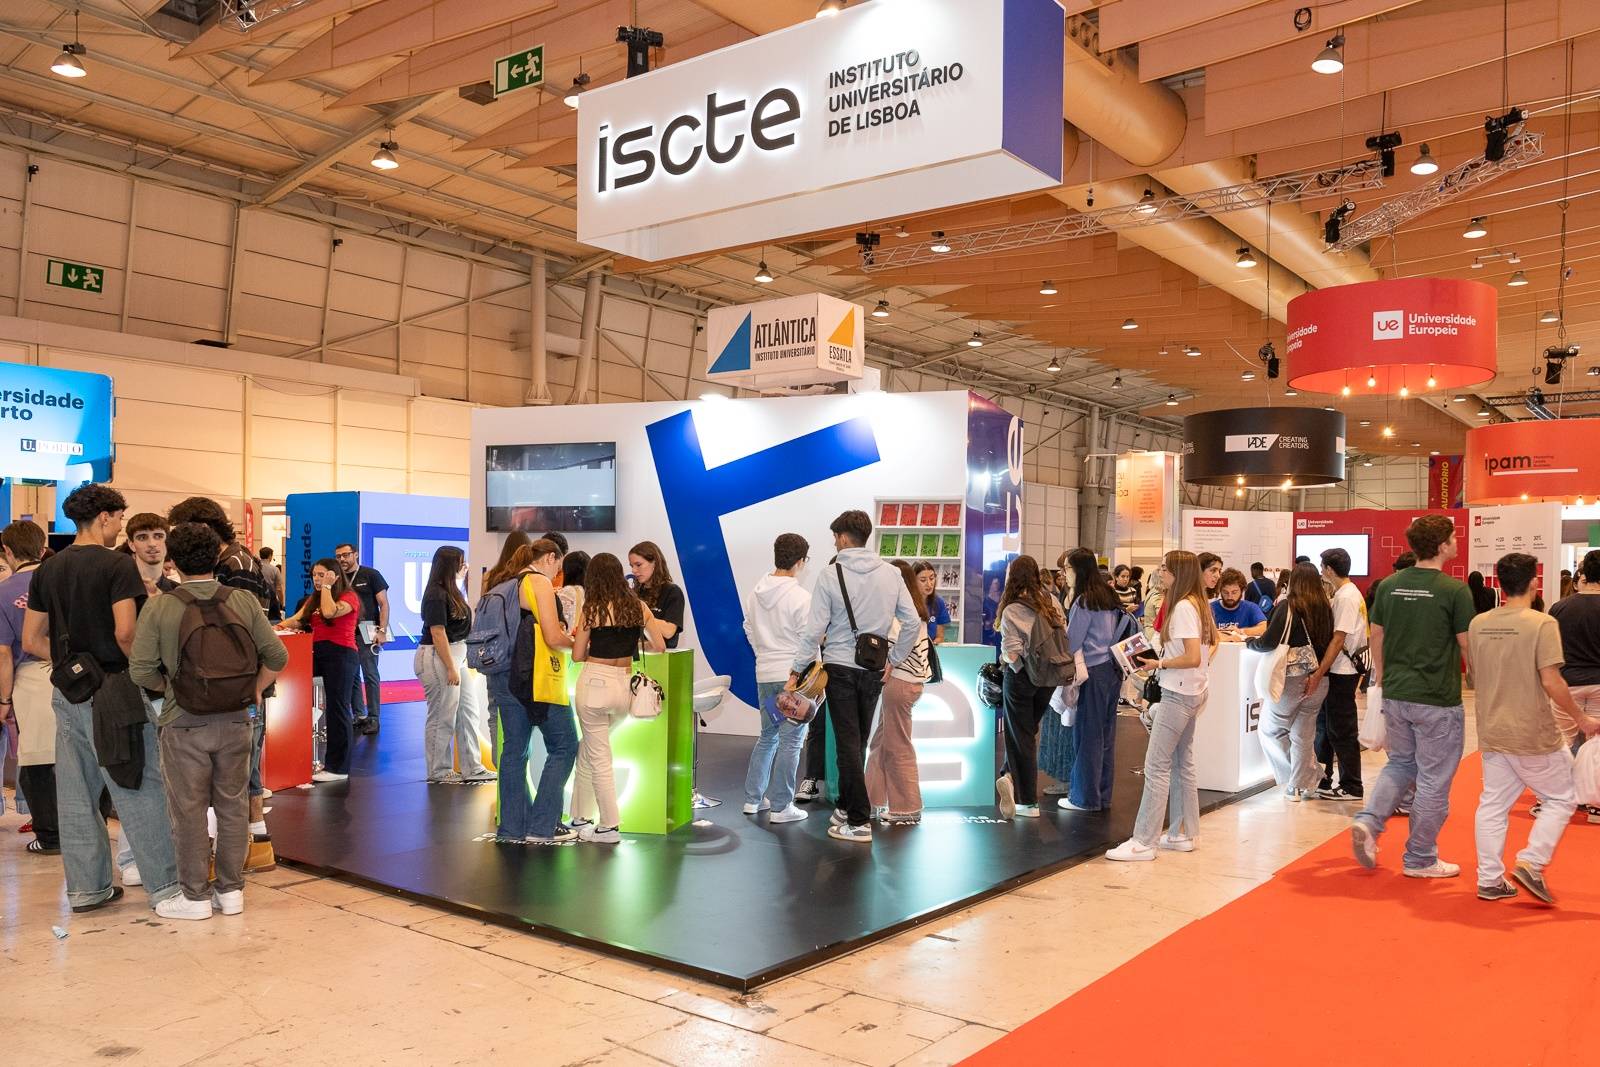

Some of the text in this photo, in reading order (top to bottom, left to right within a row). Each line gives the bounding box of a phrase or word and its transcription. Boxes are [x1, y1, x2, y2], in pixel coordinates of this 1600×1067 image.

[829, 49, 920, 89] INSTITUTO
[829, 62, 964, 112] UNIVERSITÁRIO
[828, 99, 921, 137] DE LISBOA
[598, 87, 801, 193] iscte
[1408, 313, 1477, 326] Universidade
[1408, 324, 1458, 336] Europeia
[754, 316, 816, 349] ATLÂNTICA
[755, 346, 816, 361] INSTITUTO UNIVERSITÁRIO
[829, 345, 852, 364] ESSATLA
[0, 388, 84, 409] rsidade
[1278, 435, 1308, 443] CREATING
[1484, 453, 1531, 476] ipam
